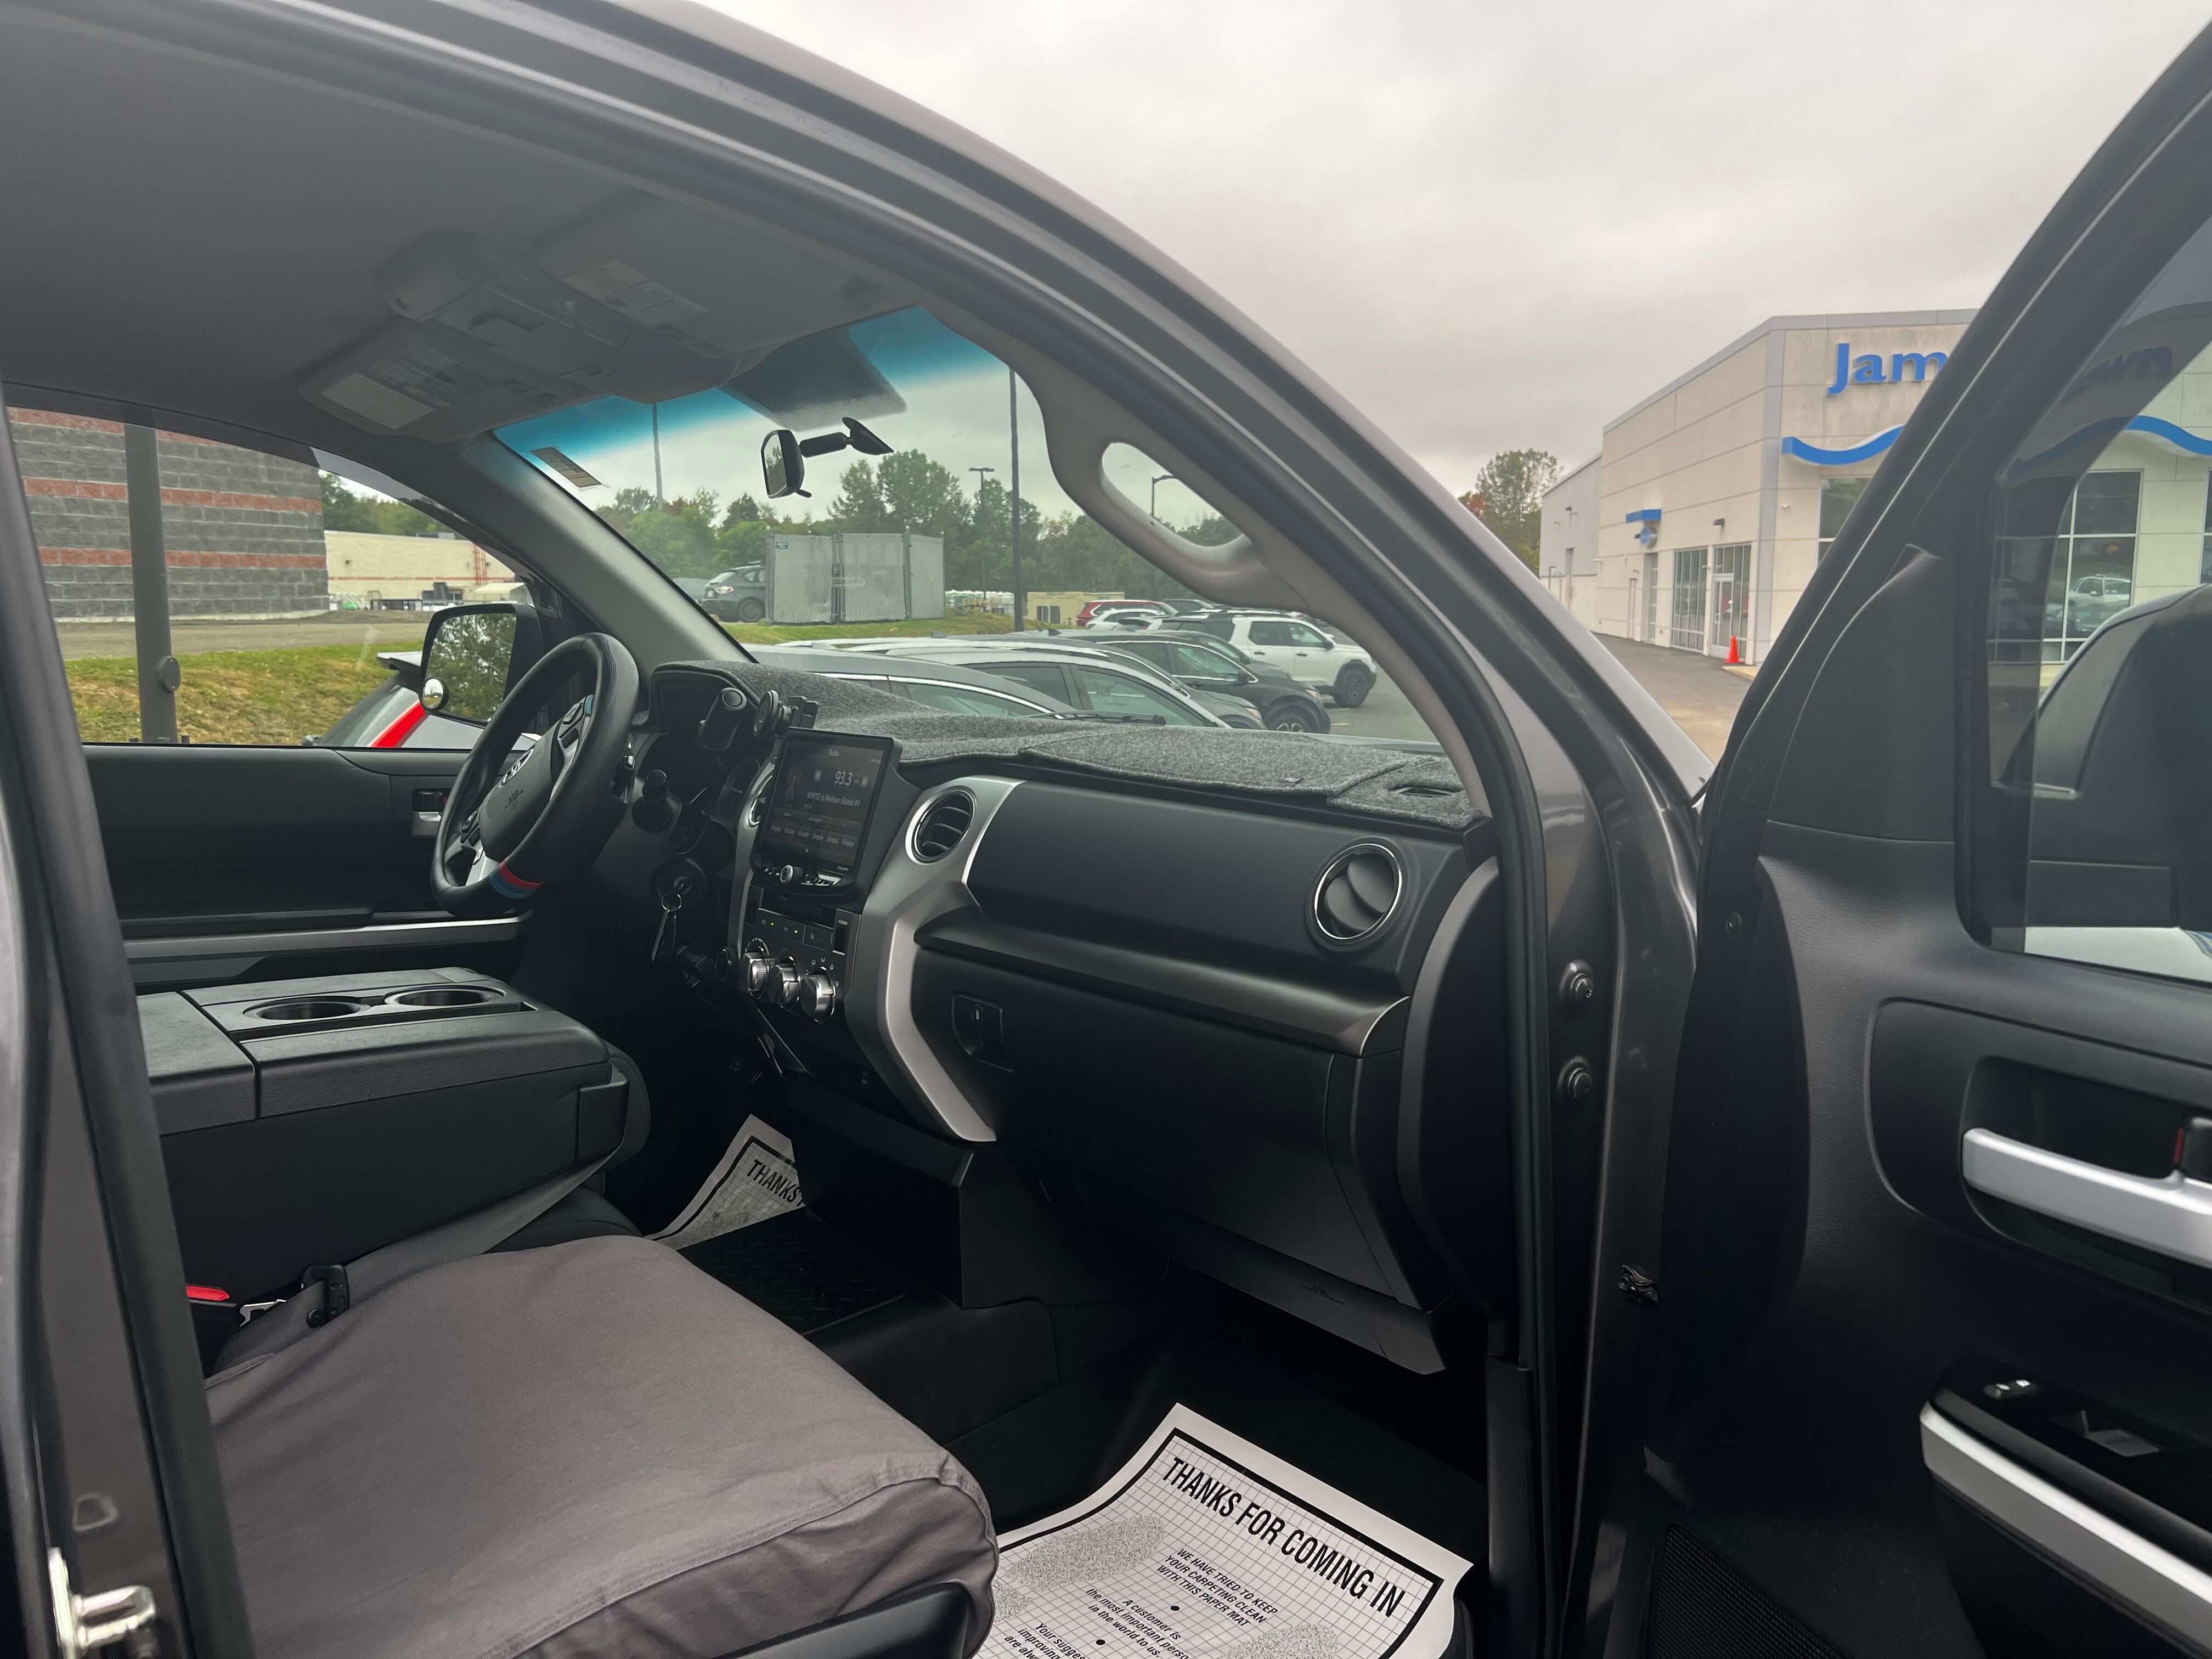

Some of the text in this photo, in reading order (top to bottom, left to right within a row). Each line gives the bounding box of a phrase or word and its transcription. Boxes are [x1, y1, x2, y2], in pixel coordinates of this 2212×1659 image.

[834, 770, 853, 786] 93.3
[747, 1159, 801, 1203] THANKS
[1163, 1457, 1406, 1618] THANKS FOR COMING IN
[1156, 1565, 1251, 1627] WITH THIS PAPER MAT
[1164, 1555, 1267, 1624] YOUR CARPETING CLEAN
[1177, 1548, 1278, 1615] WE HAVE TRIED TO KEEP
[1004, 1636, 1022, 1647] are
[1035, 1623, 1057, 1639] Your
[1086, 1588, 1189, 1659] the most important perso
[1087, 1604, 1161, 1658] in the world to us.
[1130, 1605, 1172, 1632] customer
[1169, 1632, 1181, 1640] is
